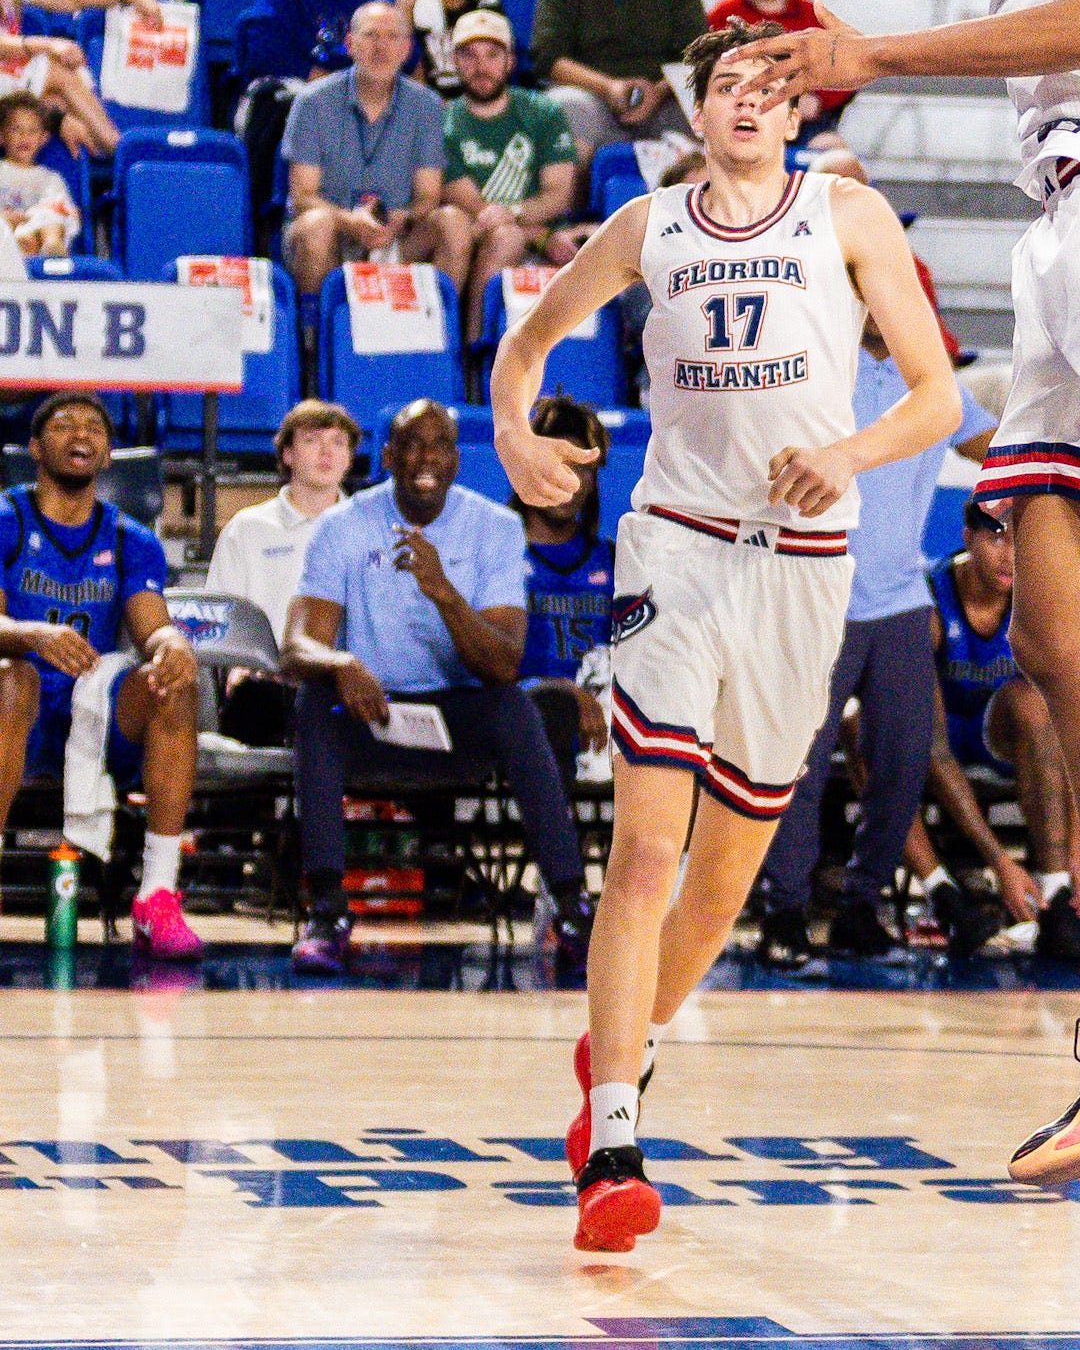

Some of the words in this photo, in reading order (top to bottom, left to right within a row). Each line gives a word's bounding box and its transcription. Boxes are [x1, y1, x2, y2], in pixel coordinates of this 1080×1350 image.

[669, 256, 806, 299] FLORIDA
[102, 302, 146, 358] B
[700, 291, 769, 352] 17
[674, 351, 808, 391] ATLANTIC
[20, 568, 117, 605] Memphis
